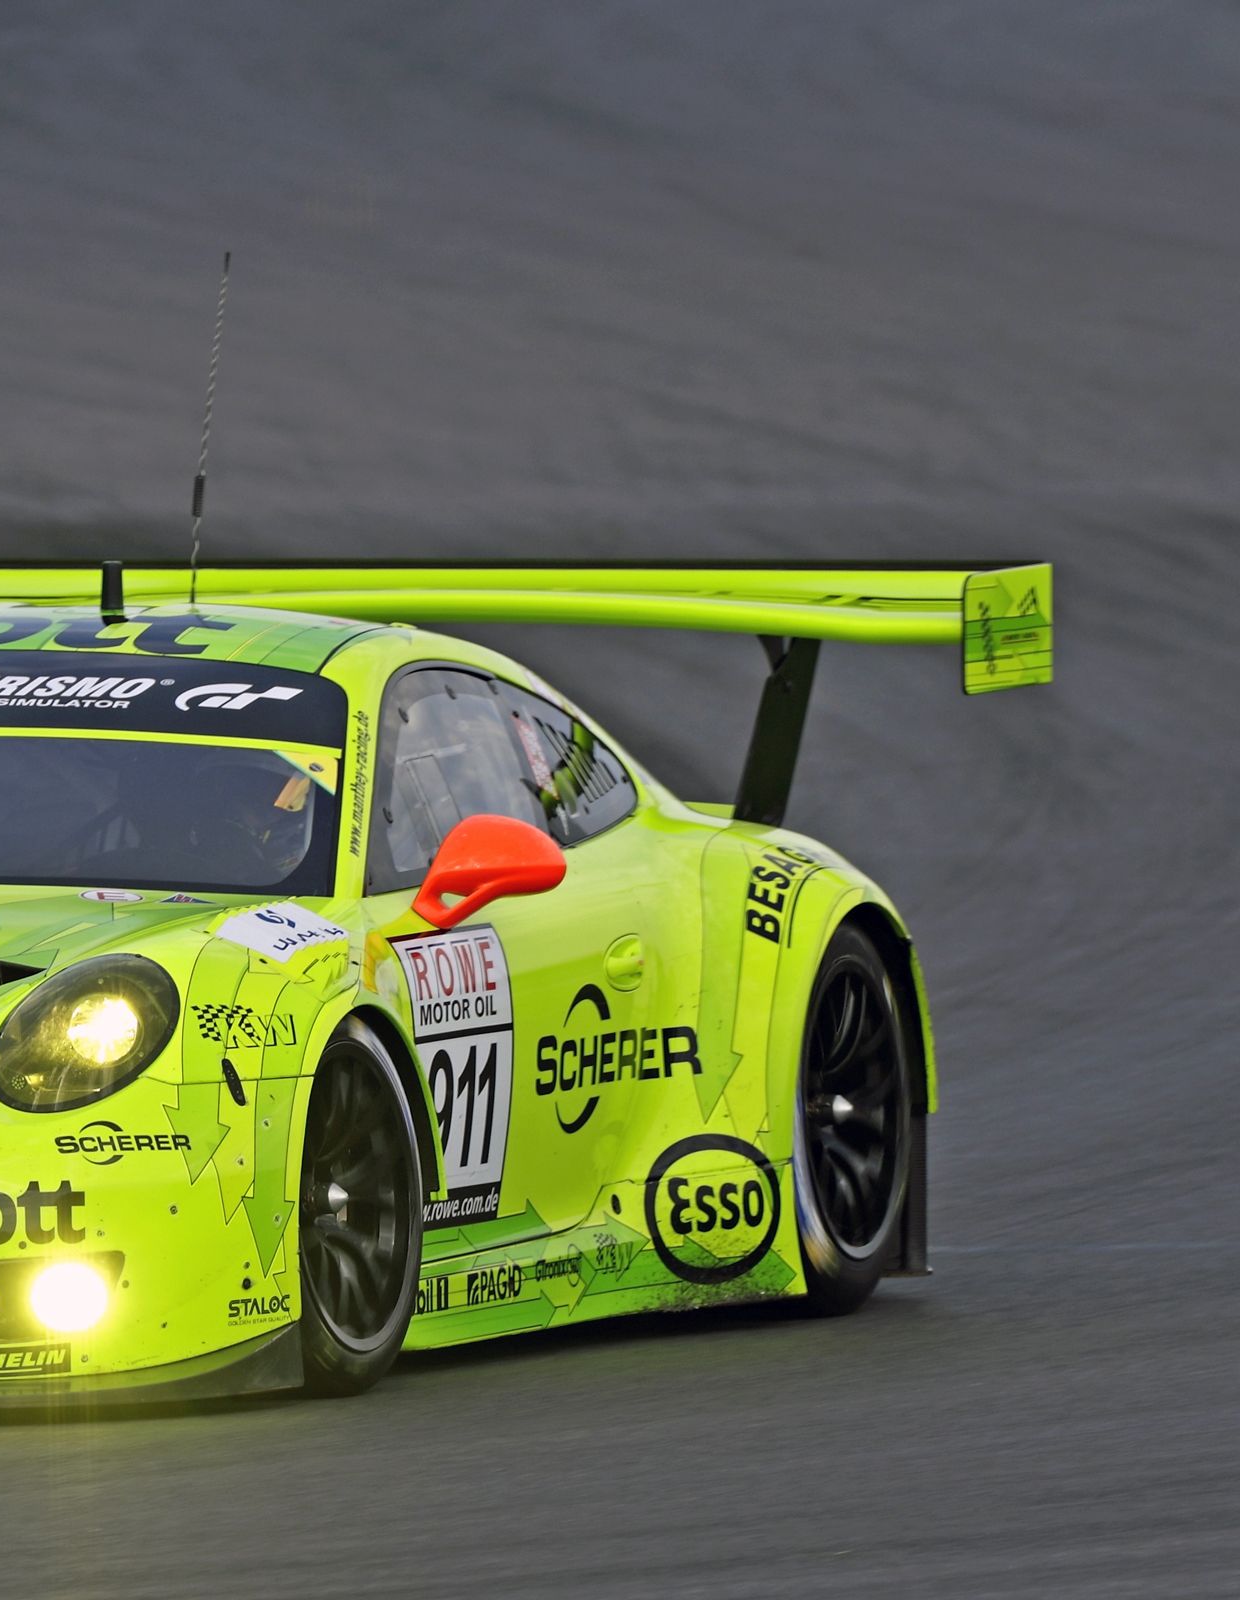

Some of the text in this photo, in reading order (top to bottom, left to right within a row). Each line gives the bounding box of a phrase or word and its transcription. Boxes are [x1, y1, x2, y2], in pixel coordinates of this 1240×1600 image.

[409, 941, 497, 1002] ROWE
[420, 995, 497, 1026] MOTOR OIL
[428, 1042, 497, 1168] 911
[480, 1264, 522, 1301] PAGID
[228, 1294, 290, 1318] STALOC
